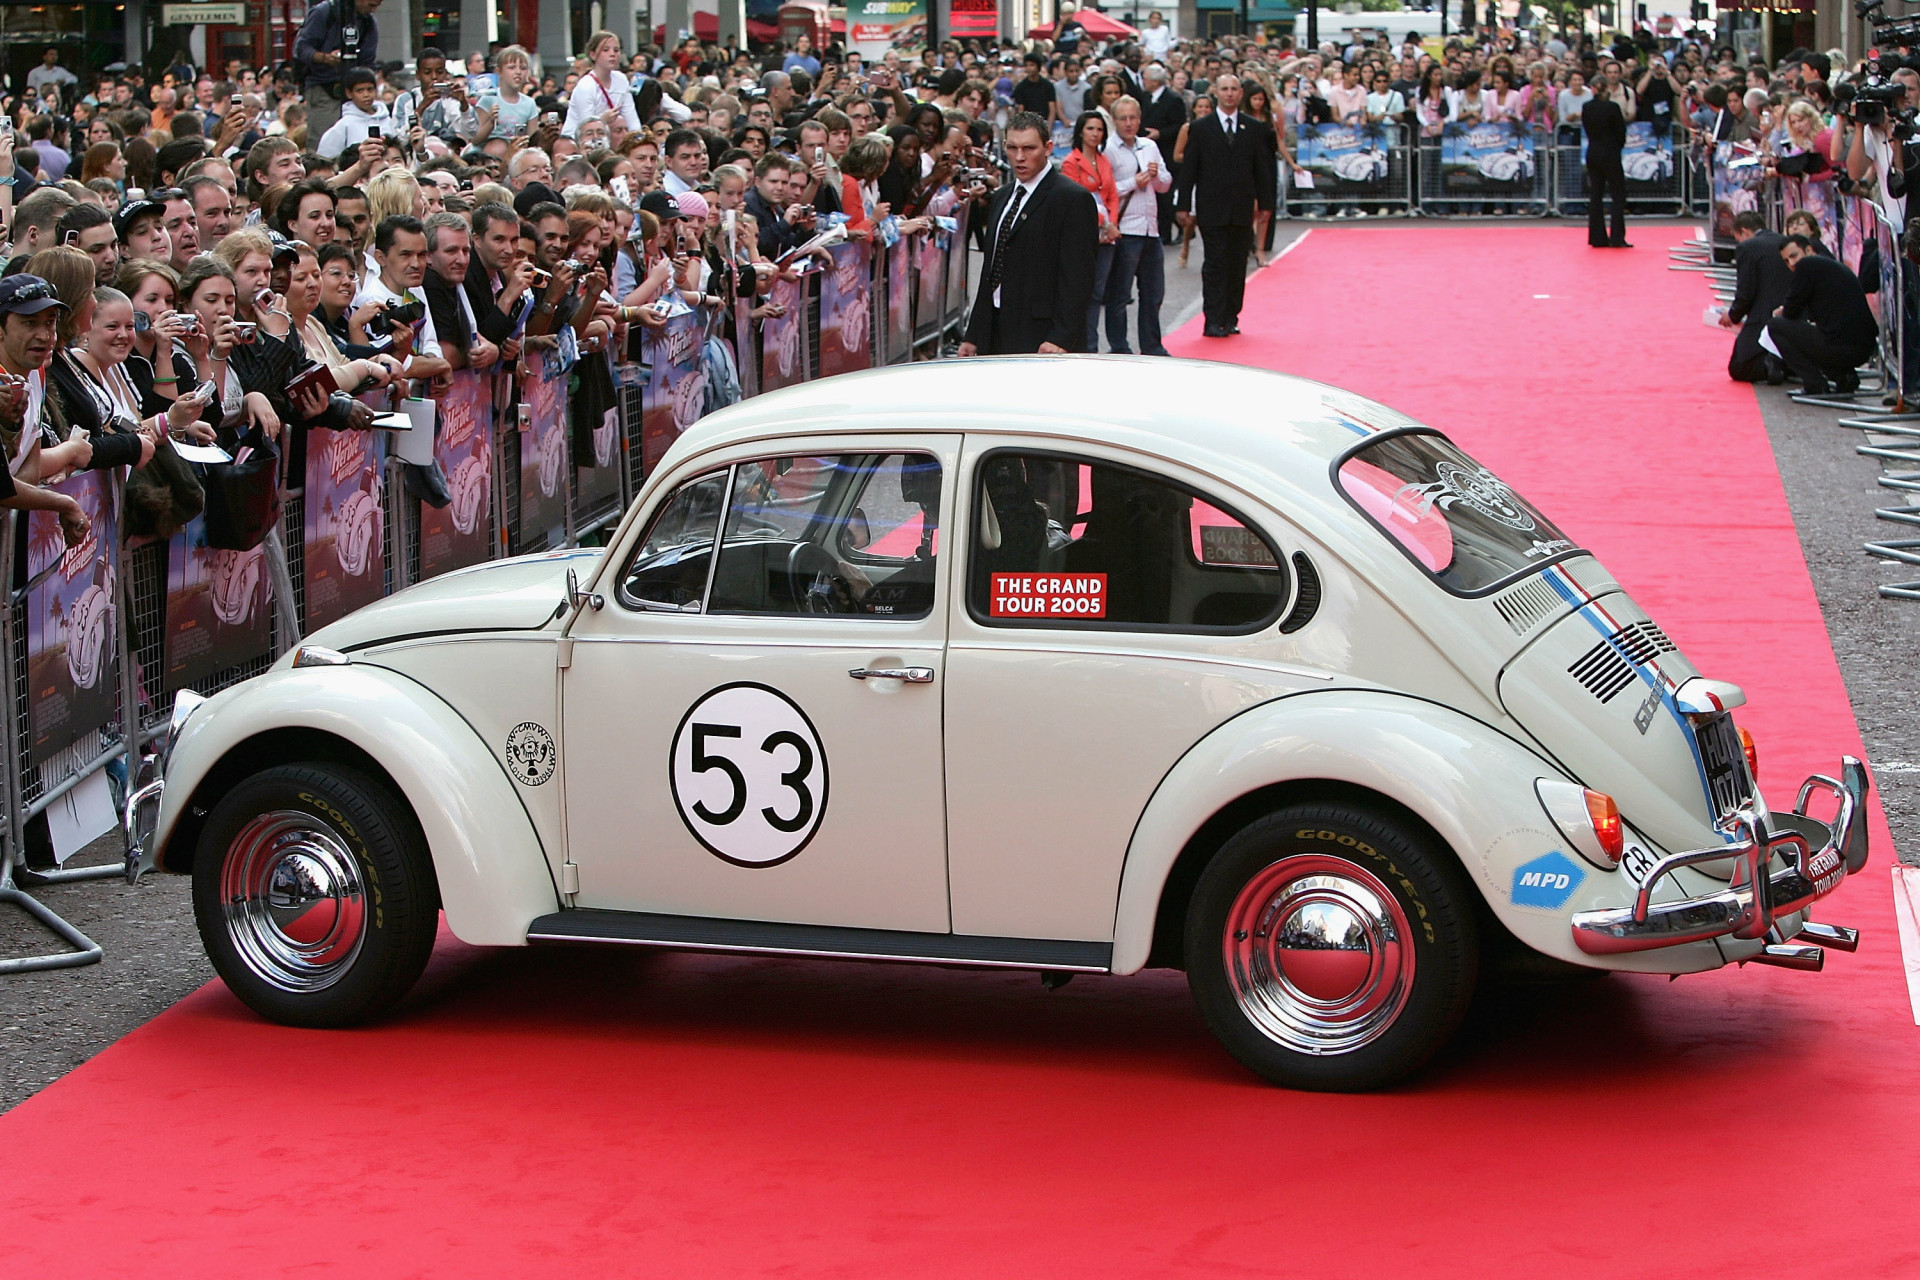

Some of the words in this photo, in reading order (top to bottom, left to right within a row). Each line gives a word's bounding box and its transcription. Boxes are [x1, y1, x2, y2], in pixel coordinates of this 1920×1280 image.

[862, 2, 917, 14] SUBWAY
[446, 402, 471, 440] Herbie
[331, 432, 360, 475] Herbie
[997, 578, 1032, 593] THE
[1036, 578, 1102, 594] GRAND
[996, 597, 1046, 613] TOUR
[1050, 597, 1101, 613] 2005
[691, 723, 814, 833] 53
[298, 792, 384, 929] GOODYEAR
[1622, 846, 1654, 884] GB
[1809, 858, 1825, 878] THE
[1296, 829, 1435, 944] GOODYEAR
[1519, 872, 1570, 890] MPD
[1814, 875, 1832, 896] TOUR
